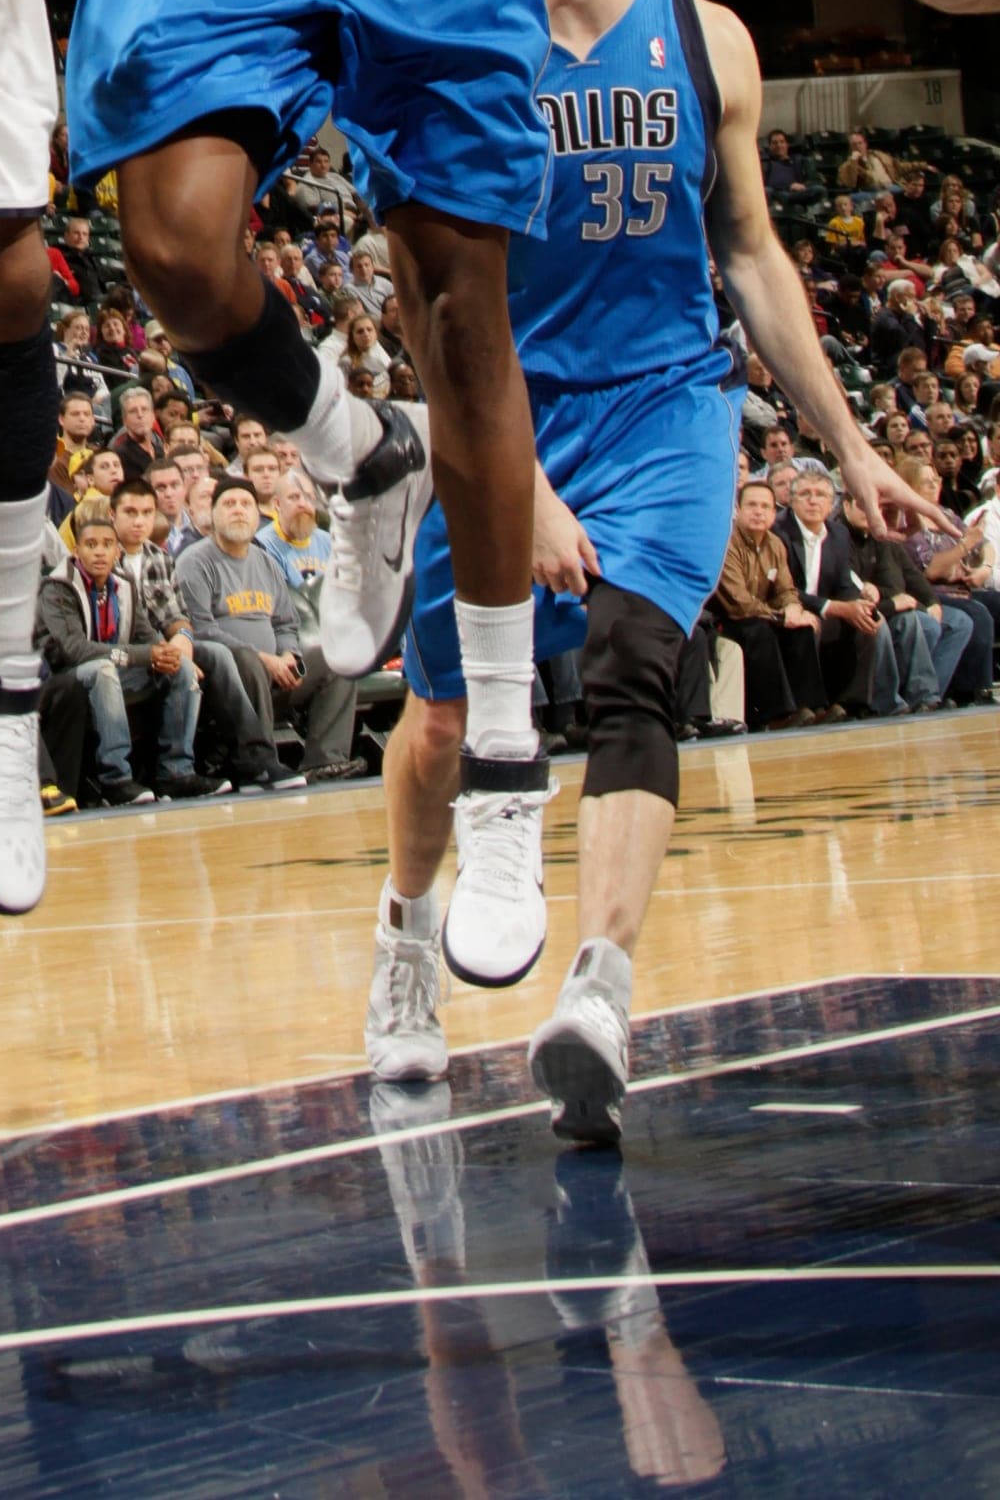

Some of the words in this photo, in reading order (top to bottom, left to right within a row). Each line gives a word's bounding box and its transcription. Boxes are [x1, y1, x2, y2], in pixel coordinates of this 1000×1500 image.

[535, 89, 679, 157] ALLAS
[924, 80, 943, 105] 18
[580, 162, 674, 242] 35
